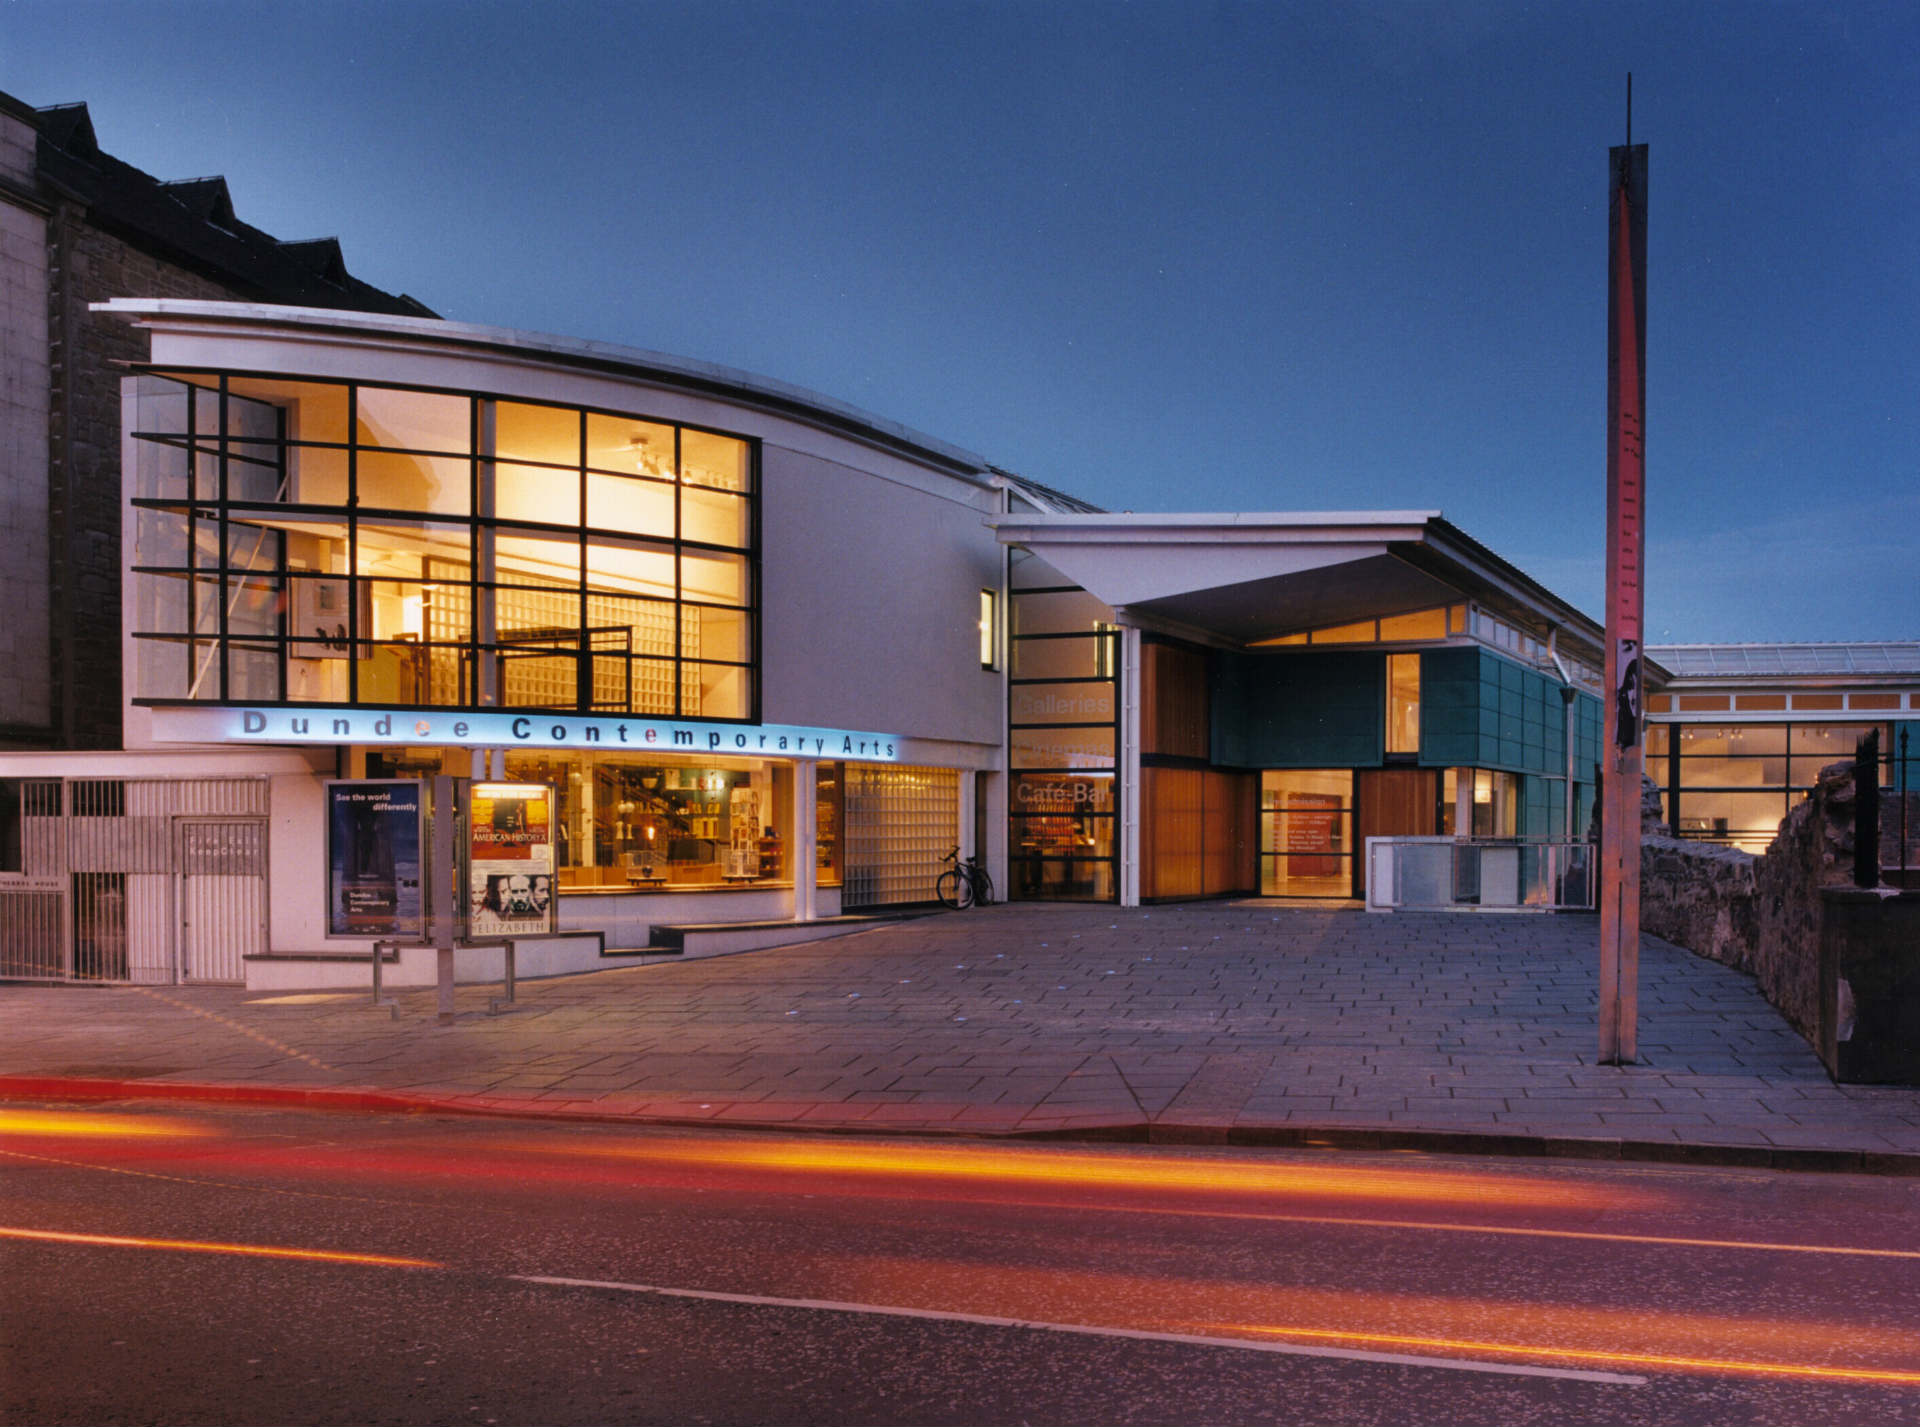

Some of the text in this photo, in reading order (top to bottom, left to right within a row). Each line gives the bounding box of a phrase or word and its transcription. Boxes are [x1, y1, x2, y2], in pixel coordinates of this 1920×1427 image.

[1015, 694, 1109, 714] Galleries
[242, 710, 895, 758] Dundee Contemporary Arts
[1016, 739, 1110, 760] Cinemas
[336, 792, 391, 802] See the world
[1016, 782, 1108, 803] Café-Bar
[372, 802, 417, 812] differently
